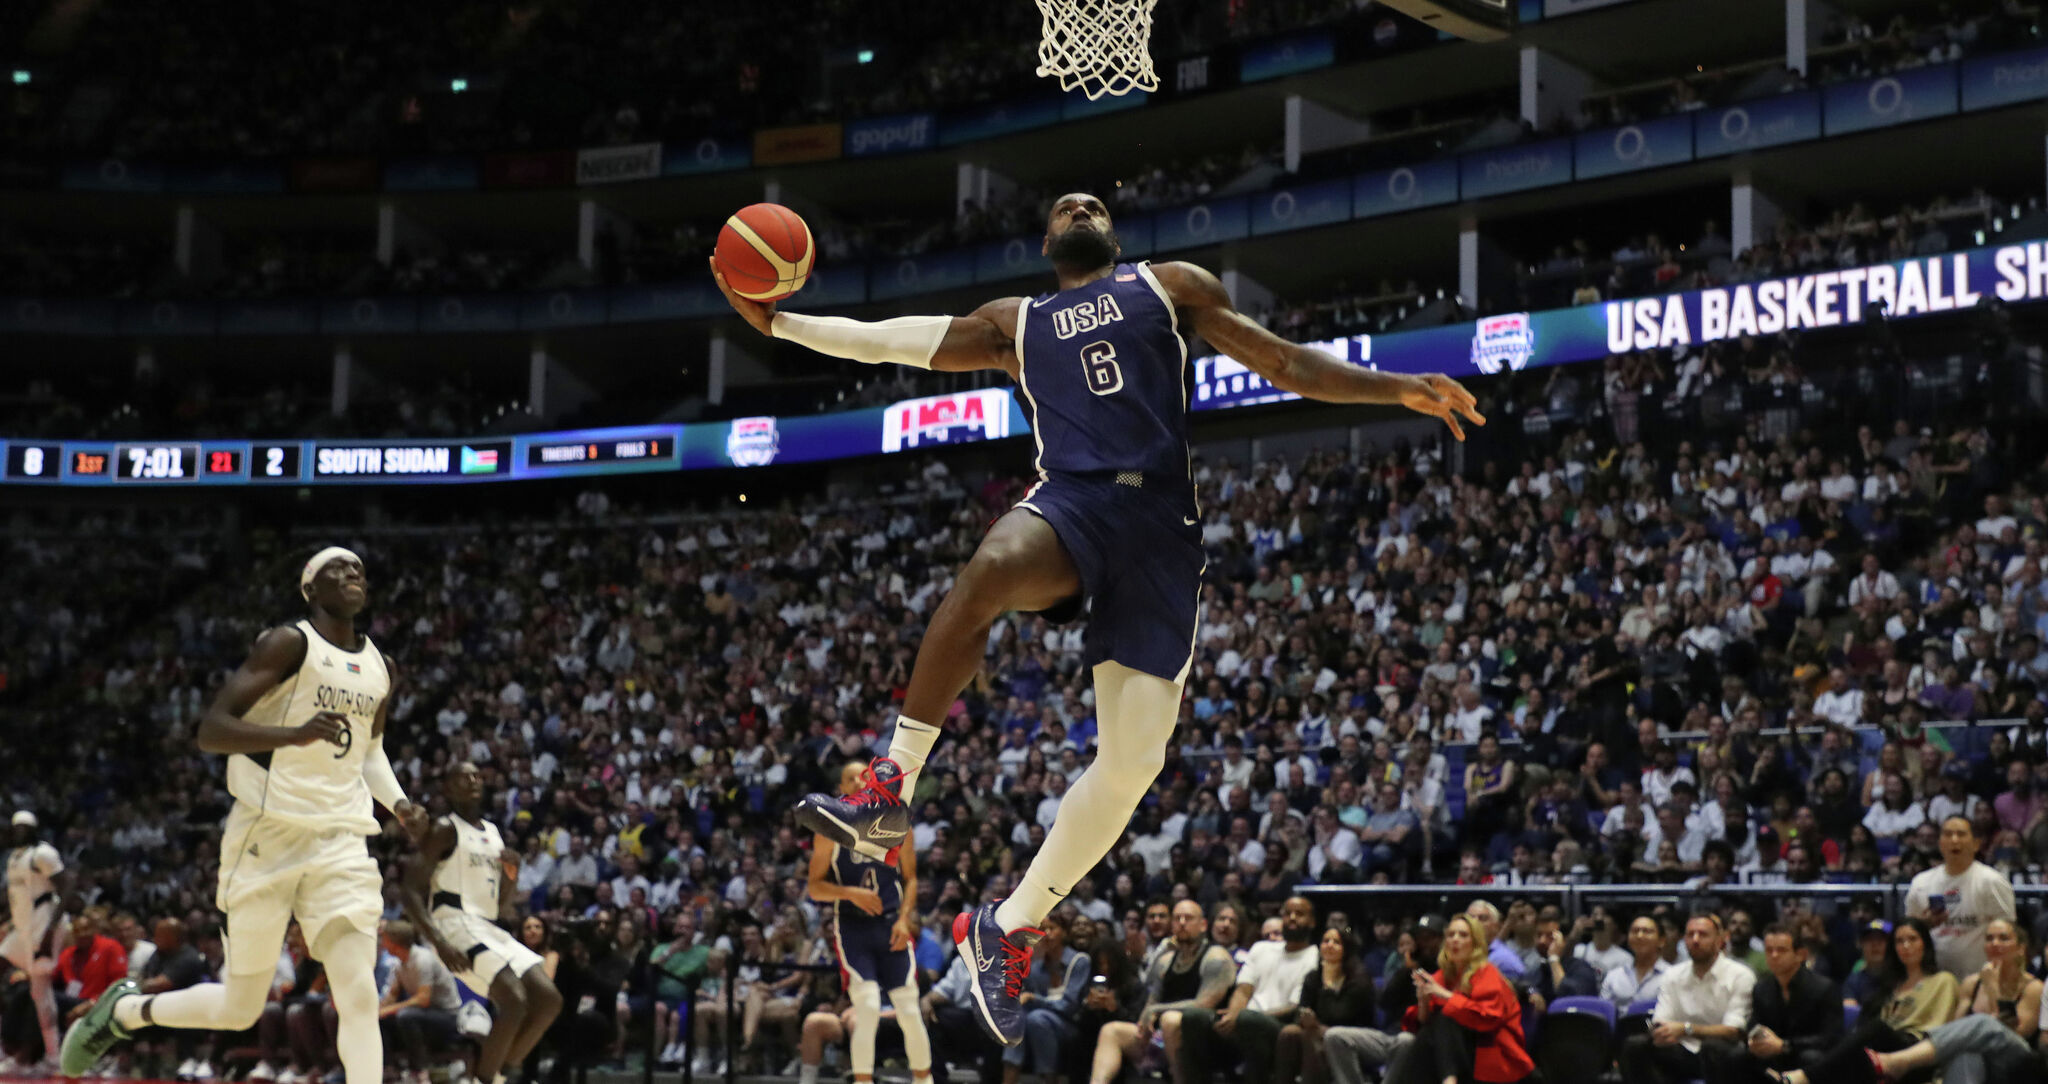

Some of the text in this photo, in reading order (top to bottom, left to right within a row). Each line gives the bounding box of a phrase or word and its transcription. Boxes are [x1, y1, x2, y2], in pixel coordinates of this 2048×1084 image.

[1176, 55, 1210, 92] FIAT
[852, 114, 929, 154] gopuff
[1052, 293, 1124, 340] USA
[1605, 294, 1692, 354] USA
[1700, 252, 1983, 343] BASKETBALL
[1080, 340, 1124, 396] 6
[23, 447, 45, 476] 8
[128, 447, 185, 478] 7:01
[210, 451, 234, 473] 21
[265, 447, 284, 476] 2
[317, 447, 449, 474] SOUTH SUDAN
[313, 683, 354, 710] SOUTH
[333, 728, 352, 759] 9
